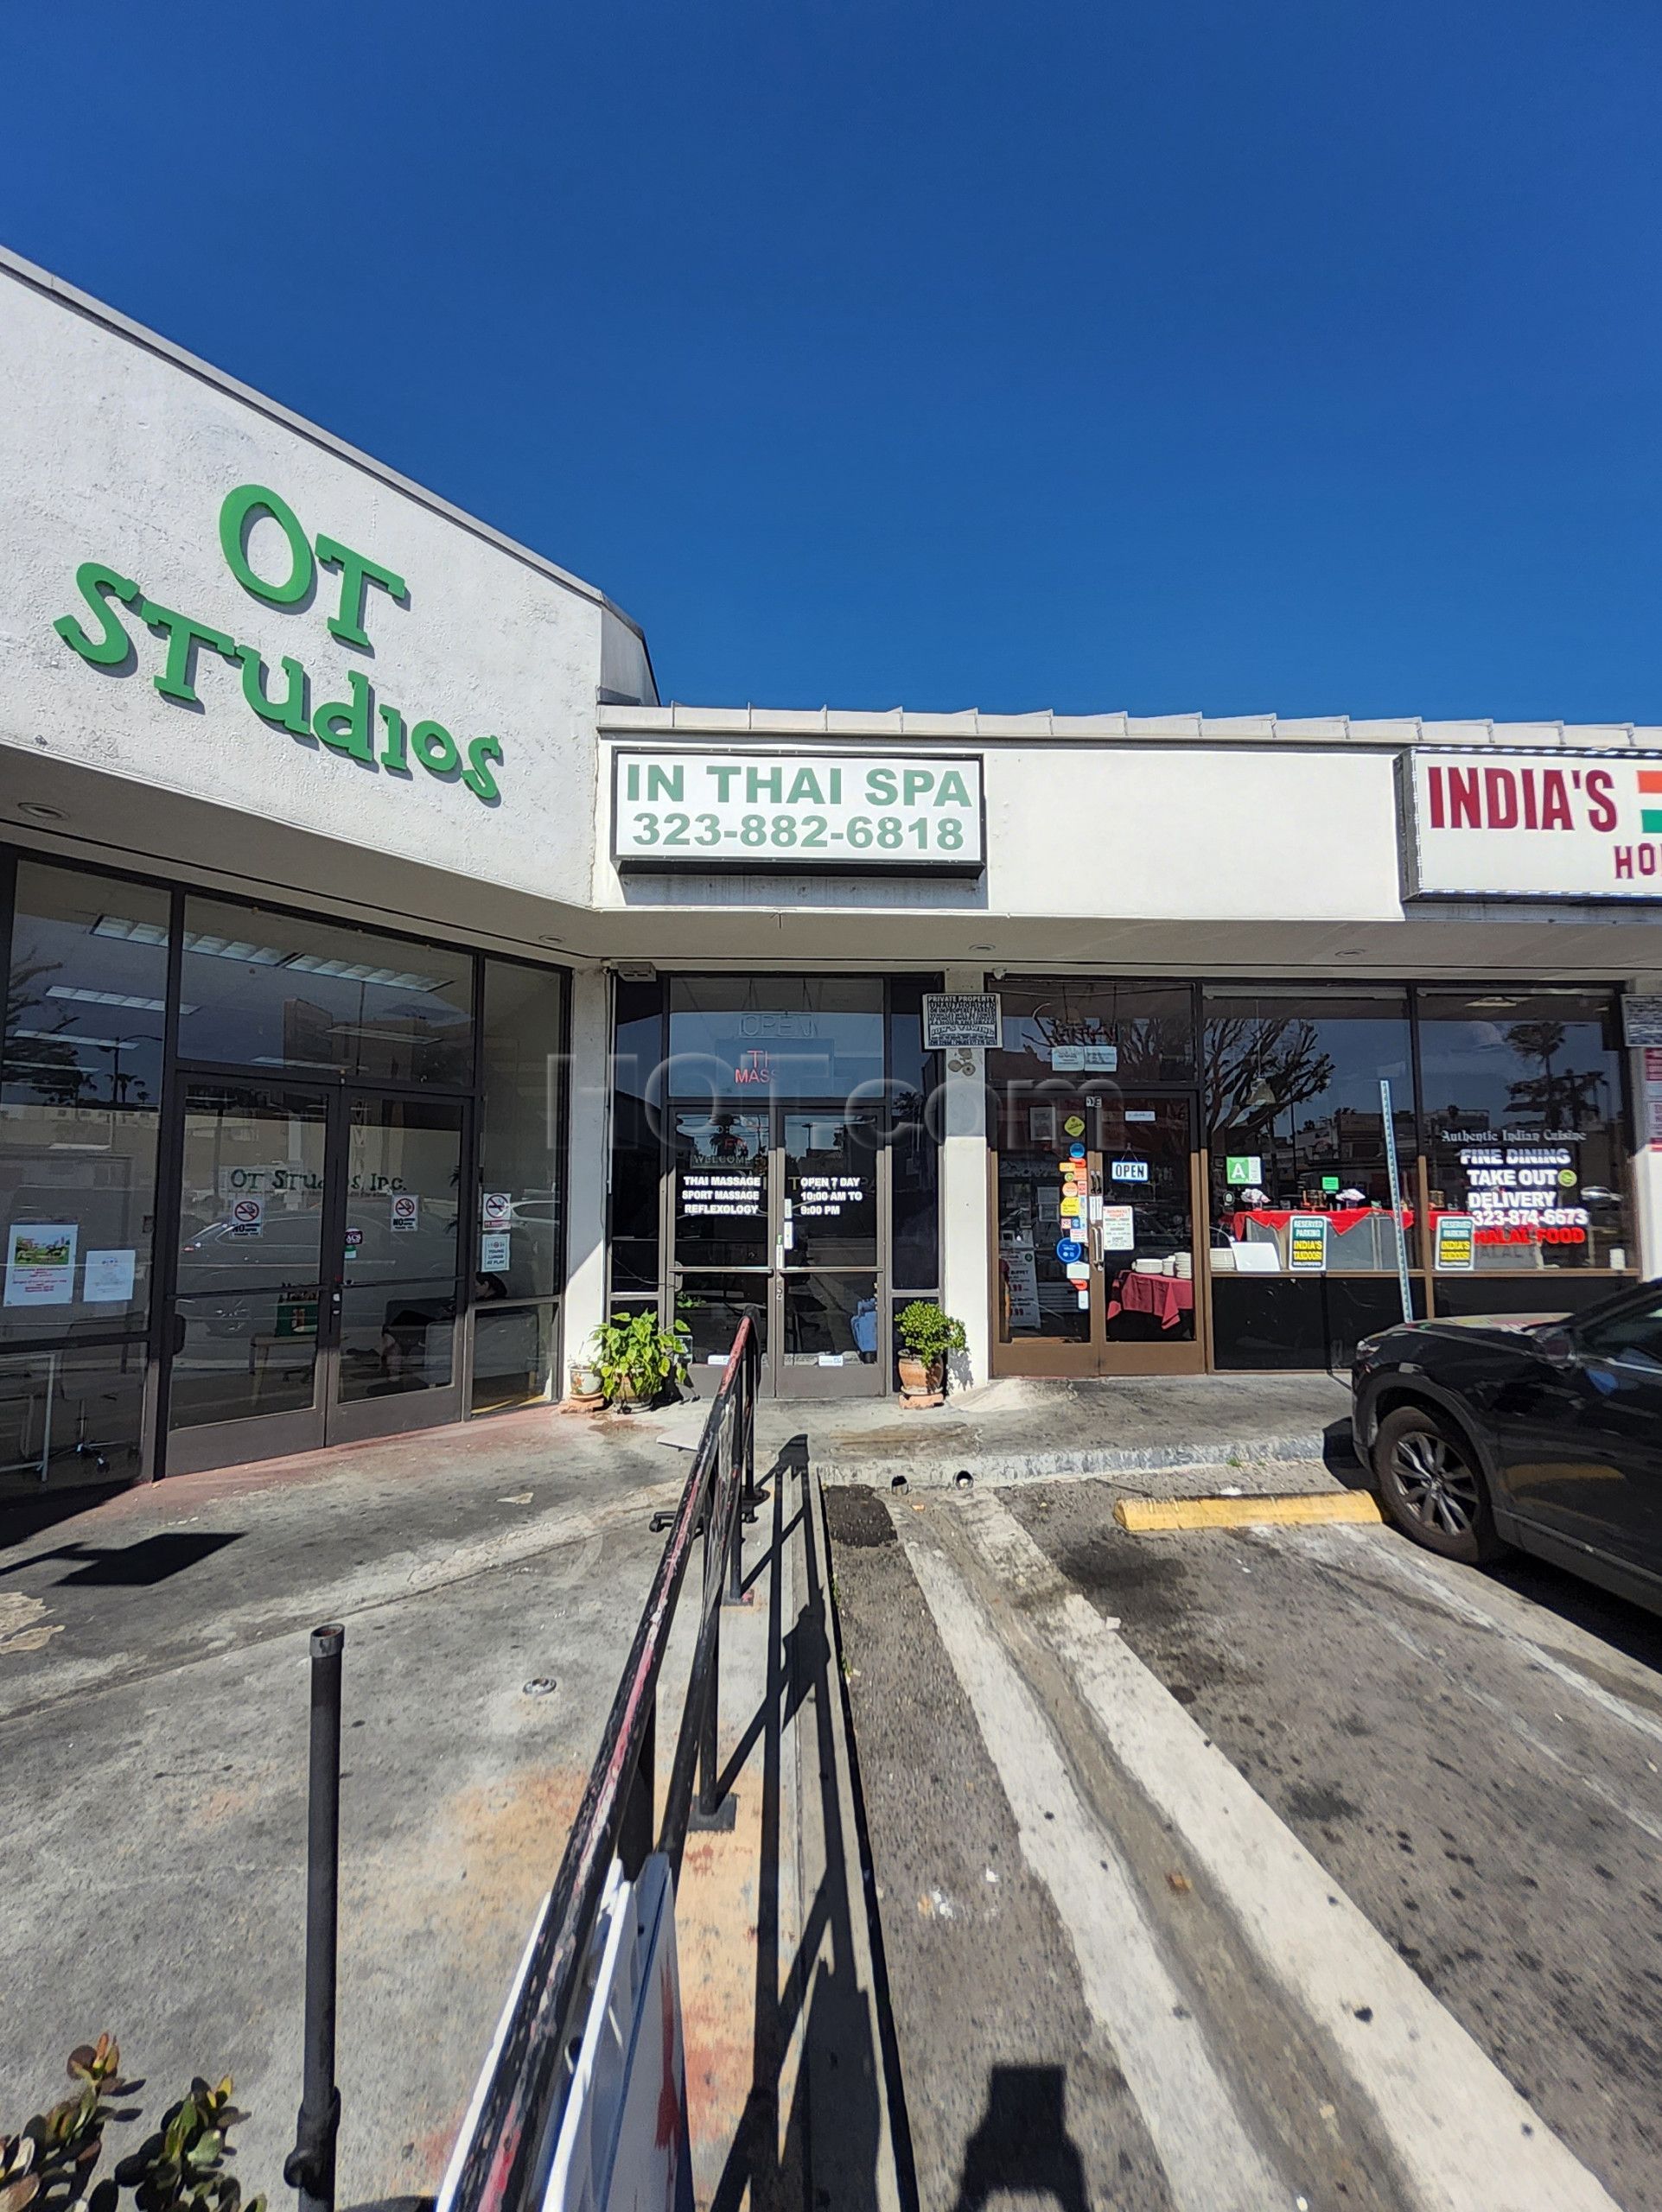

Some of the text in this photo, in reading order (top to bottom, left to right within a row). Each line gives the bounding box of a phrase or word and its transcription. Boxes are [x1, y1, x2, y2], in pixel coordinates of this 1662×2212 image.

[219, 483, 408, 647] OT
[627, 764, 972, 808] IN THAI SPA
[1427, 766, 1618, 833] INDIA'S
[632, 812, 965, 850] 323-882-6818
[1442, 1128, 1587, 1142] Authentic Indian Cuisine
[693, 1154, 751, 1164] WELCOME
[1460, 1148, 1571, 1165] FINE DINING
[1115, 1164, 1144, 1178] OPEN
[1231, 1162, 1246, 1179] A
[1467, 1169, 1558, 1186] TAKE OUT
[230, 1168, 264, 1190] OT
[683, 1176, 710, 1185] THAI
[710, 1176, 761, 1187] MASSAGE
[800, 1177, 830, 1187] OPEN
[831, 1178, 838, 1187] 7
[839, 1177, 861, 1187] DAY
[682, 1190, 760, 1200] SPORT MASSAGE
[800, 1192, 863, 1201] 10:00 AM TO
[1468, 1191, 1557, 1209] DELIVERY
[684, 1204, 760, 1215] REFLEXOLOGY
[800, 1206, 823, 1216] 9:00
[824, 1206, 840, 1216] PM
[1536, 1227, 1585, 1245] FOOD
[1293, 1240, 1322, 1250] INDIA'S
